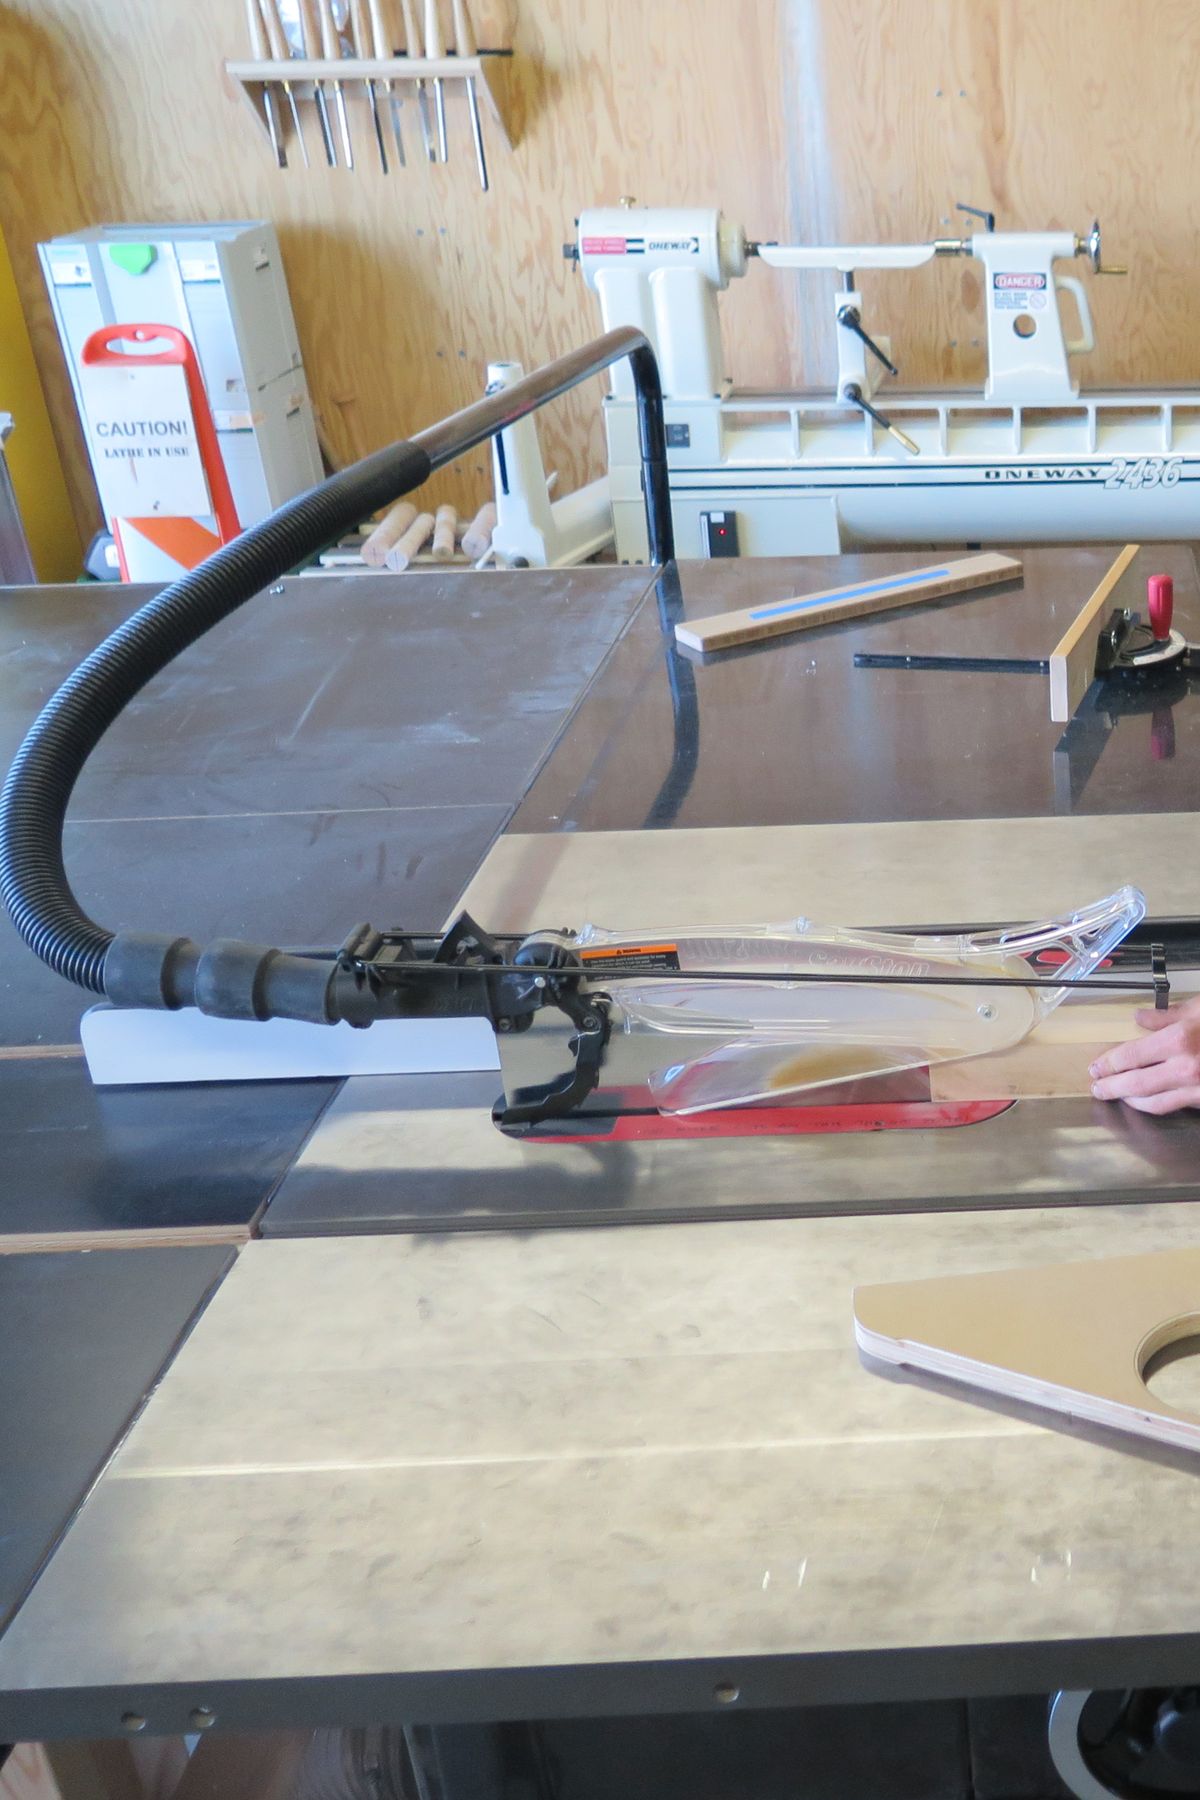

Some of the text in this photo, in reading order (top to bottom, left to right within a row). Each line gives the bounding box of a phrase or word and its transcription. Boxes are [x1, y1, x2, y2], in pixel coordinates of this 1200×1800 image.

[648, 241, 692, 251] ONEWAY
[998, 276, 1042, 287] DANGER
[95, 420, 189, 438] CAUTION!
[103, 446, 190, 459] LATHE IN USE
[984, 456, 1185, 490] ONEWAY 2436
